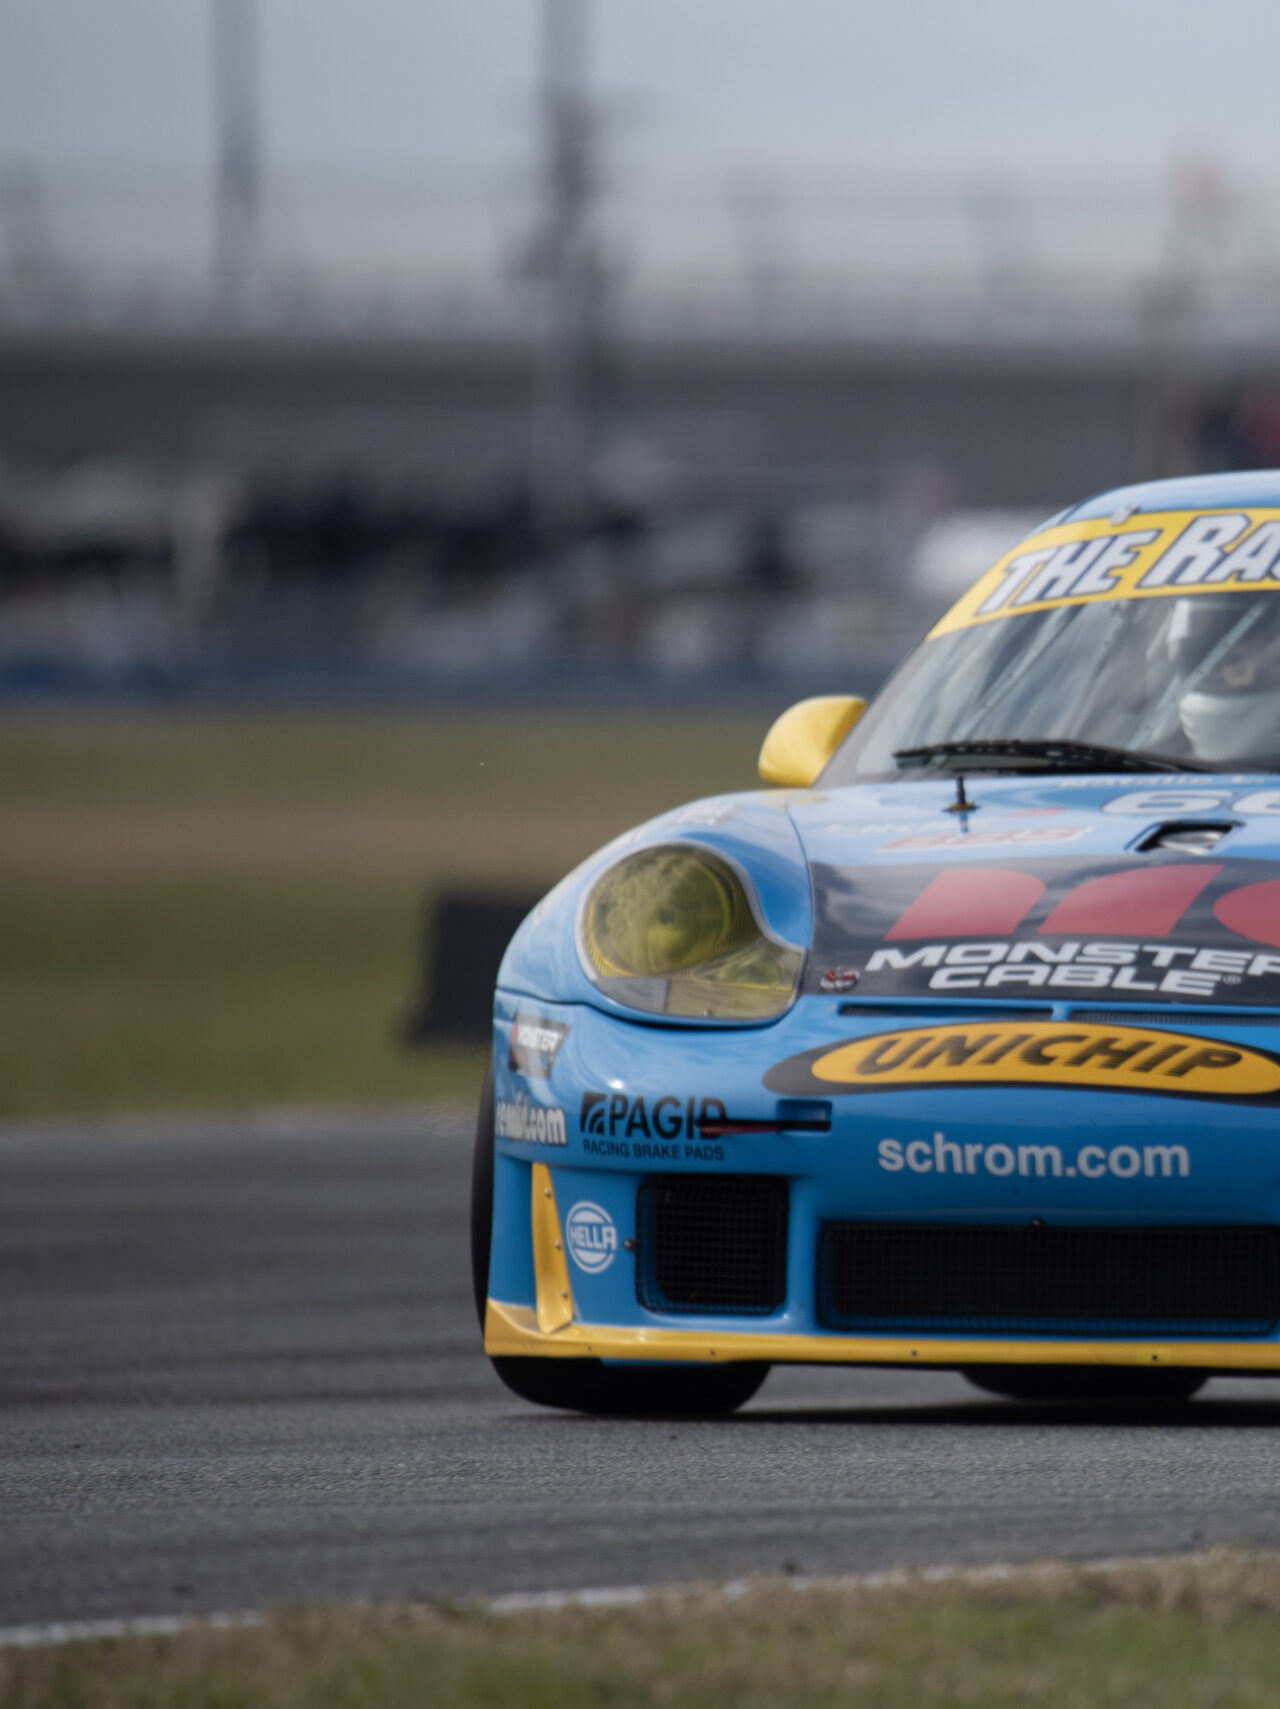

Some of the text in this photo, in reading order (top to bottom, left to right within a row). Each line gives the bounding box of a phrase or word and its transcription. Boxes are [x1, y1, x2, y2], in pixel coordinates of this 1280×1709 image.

[975, 529, 1162, 616] THE
[855, 1033, 1242, 1078] UNICHIP
[609, 1095, 728, 1141] PAGID
[583, 1139, 724, 1161] RACING BRAKE PADS
[877, 1132, 1191, 1178] schrom.com
[570, 1226, 618, 1250] HELLA
